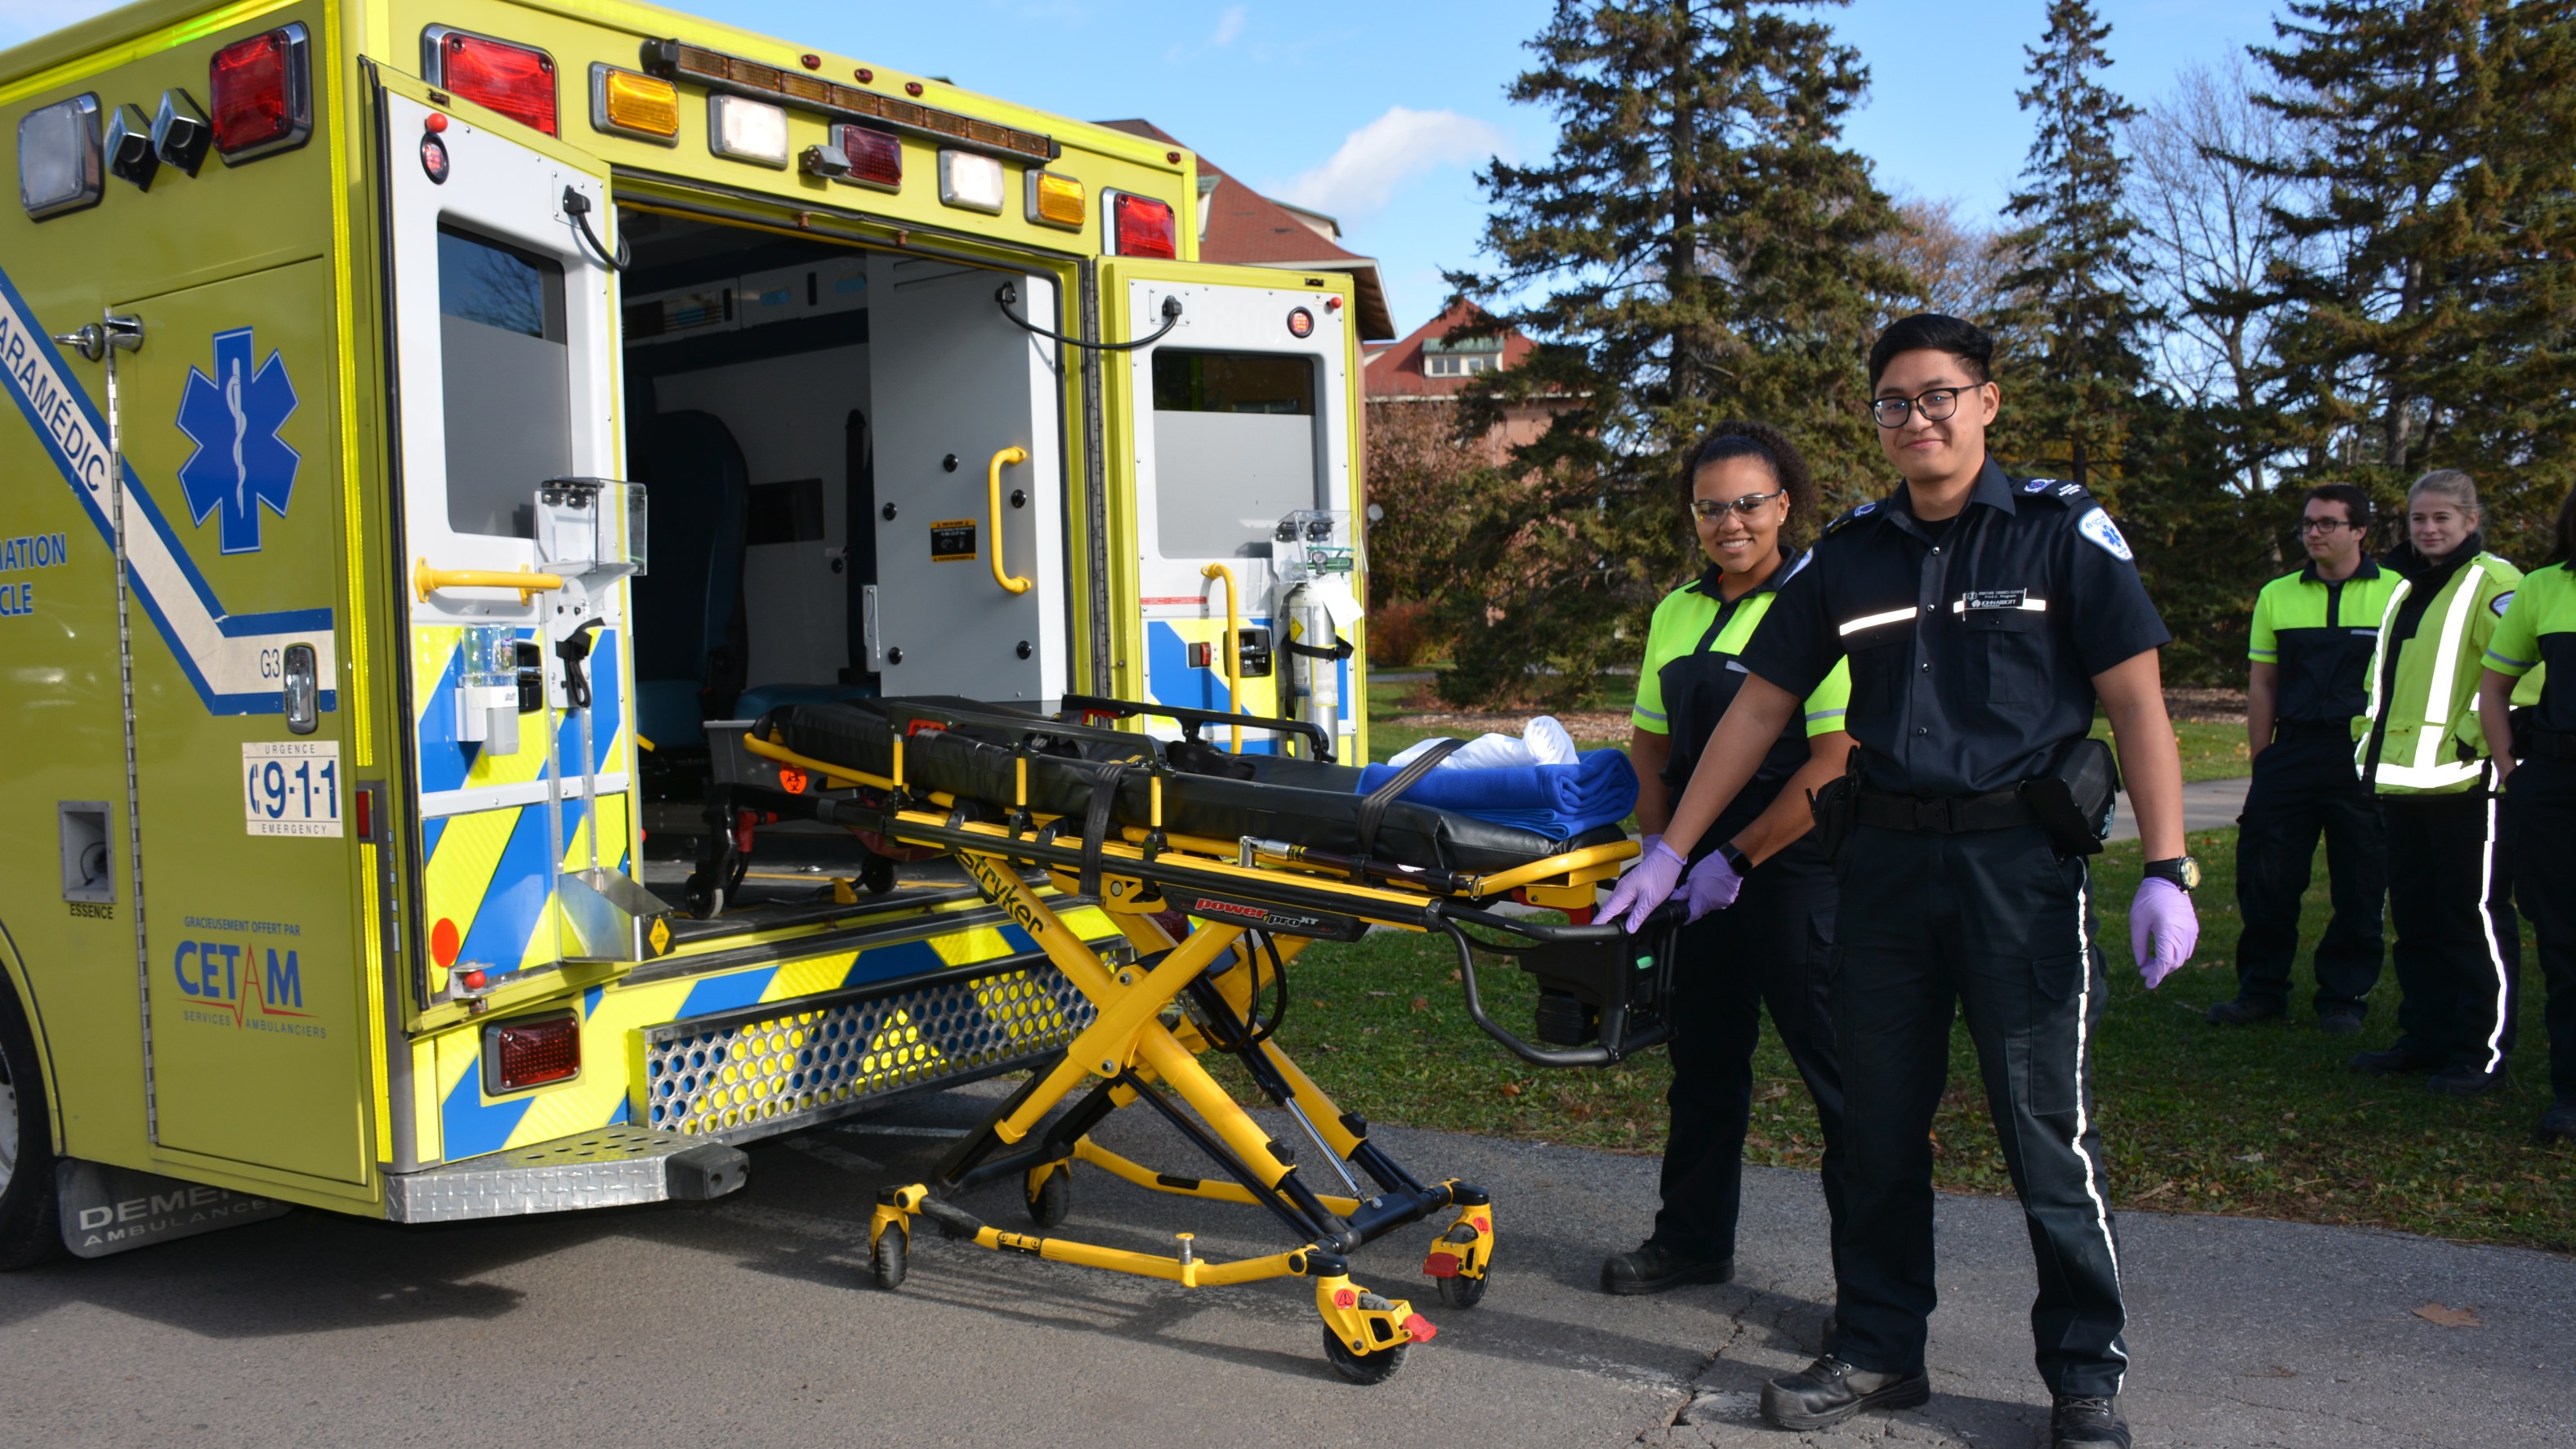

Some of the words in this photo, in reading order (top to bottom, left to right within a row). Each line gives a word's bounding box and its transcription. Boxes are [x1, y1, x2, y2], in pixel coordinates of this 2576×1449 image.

[0, 534, 66, 570] ATION
[0, 583, 33, 616] CLE
[261, 649, 280, 678] G3
[265, 744, 315, 755] URGENCE
[261, 824, 327, 834] EMERGENCY
[69, 903, 114, 920] ESSENCE
[184, 915, 249, 932] GRACIEUSEMENT
[251, 921, 282, 935] OFFERT
[283, 924, 301, 937] PAR
[174, 940, 303, 1009] CETAM
[183, 1010, 231, 1026] SERVICES
[245, 1017, 328, 1039] AMBULANCIERS
[79, 1186, 230, 1231] DEME
